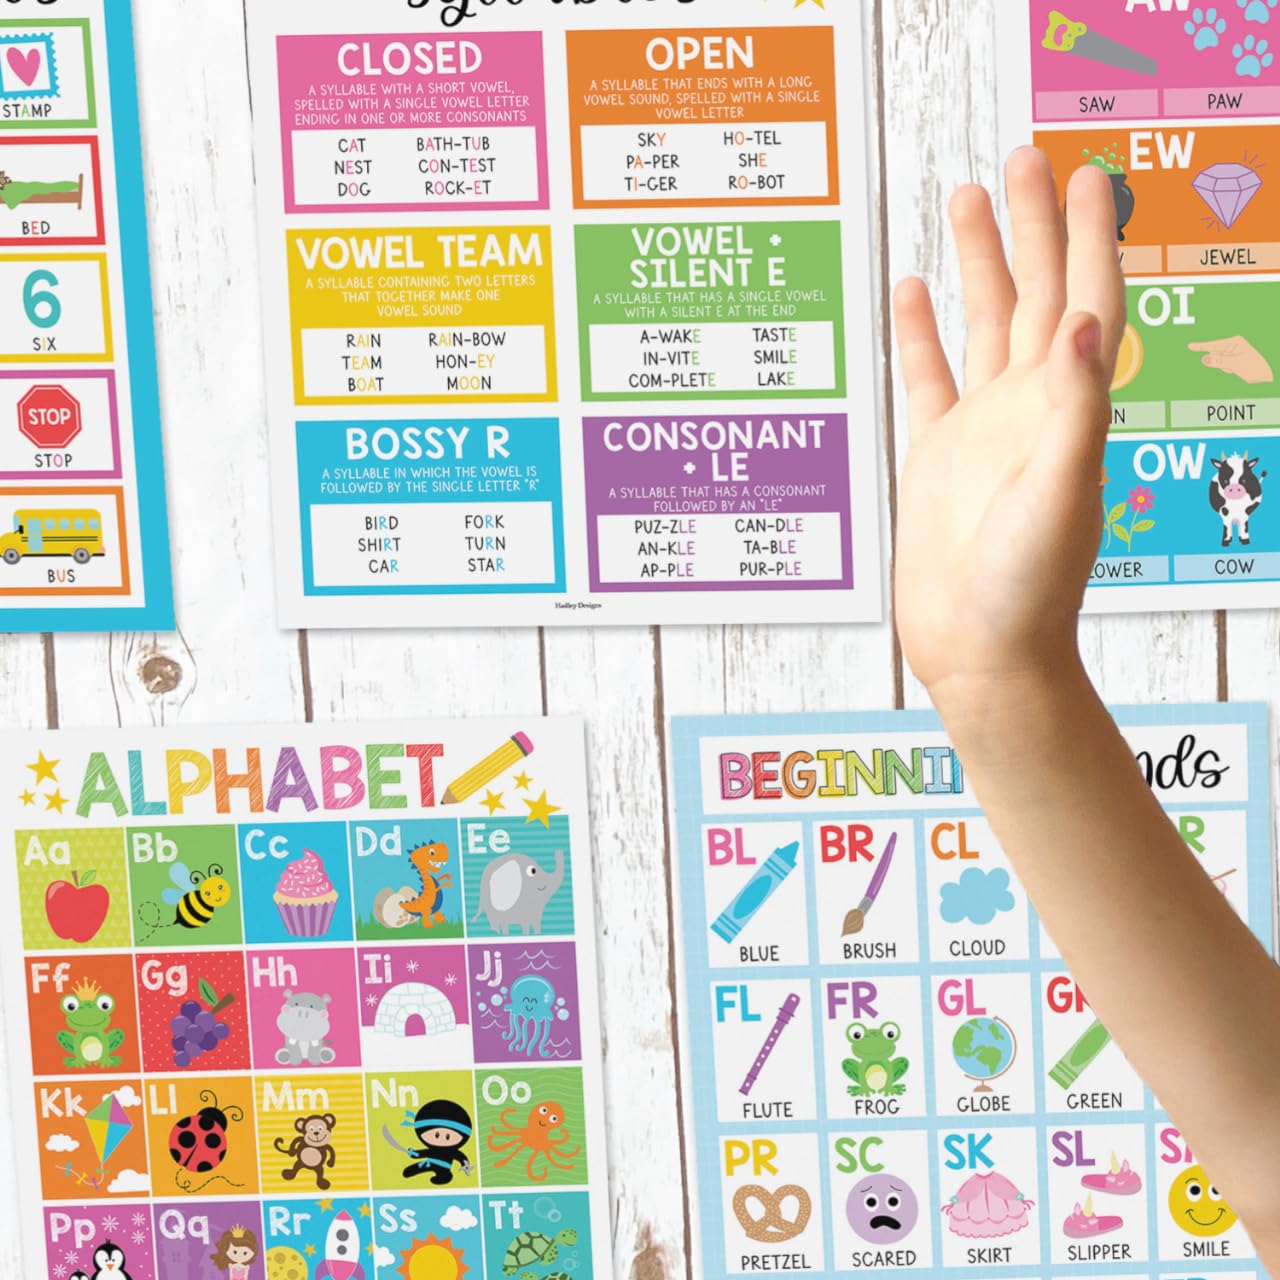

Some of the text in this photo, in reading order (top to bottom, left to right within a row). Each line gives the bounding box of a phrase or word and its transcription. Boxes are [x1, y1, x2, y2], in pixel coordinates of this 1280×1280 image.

[338, 41, 482, 76] CLOSED
[646, 36, 754, 71] OPEN
[308, 85, 316, 96] A
[321, 84, 376, 96] SYLLABLE
[381, 83, 411, 94] WITH
[416, 83, 424, 94] A
[428, 82, 465, 94] SHORT
[1080, 96, 1115, 112] SAW
[1208, 93, 1242, 109] PAW
[3, 104, 51, 118] STAMP
[338, 138, 366, 153] CAT
[417, 136, 489, 151] BATH-TUB
[638, 133, 665, 147] SKY
[724, 130, 781, 145] HO-TEL
[1130, 131, 1195, 170] EW
[334, 160, 372, 175] NEST
[419, 158, 496, 173] CON-TEST
[627, 154, 679, 169] PA-PER
[22, 221, 50, 235] BED
[631, 225, 753, 256] VOWEL
[296, 233, 543, 270] VOWEL TEAM
[1200, 248, 1256, 265] JEWEL
[630, 257, 786, 288] SILENT E
[23, 269, 61, 328] 6
[1137, 286, 1196, 327] OI
[640, 329, 699, 343] A-WAKE
[752, 328, 796, 342] TASTE
[33, 337, 56, 351] SIX
[629, 373, 714, 388] COM-PLETE
[28, 408, 71, 425] STOP
[1207, 404, 1256, 421] POINT
[346, 425, 510, 460] BOSSY R
[604, 420, 825, 452] CONSONANT
[35, 454, 72, 468] STOP
[712, 452, 749, 481] LE
[1133, 443, 1206, 481] OW
[321, 482, 383, 493] FOLLOWED
[388, 482, 400, 493] BY
[406, 481, 427, 492] THE
[432, 480, 473, 492] SINGLE
[478, 480, 520, 492] LETTER
[365, 516, 398, 530] BIRD
[465, 515, 504, 529] FORK
[635, 520, 696, 534] PUZ-ZLE
[735, 518, 803, 533] CAN-DLE
[1215, 559, 1254, 575] COW
[48, 569, 75, 583] BUS
[75, 743, 444, 818] ALPHABET
[719, 746, 963, 800] BEGINNI
[24, 834, 71, 867] Aa
[132, 832, 178, 864] Bb
[245, 829, 289, 860] Cc
[820, 824, 875, 863] BR
[740, 945, 779, 962] BLUE
[843, 942, 896, 959] BRUSH
[950, 939, 1005, 956] CLOUD
[141, 960, 188, 996] Gg
[957, 1096, 1010, 1112] GLOBE
[1067, 1093, 1122, 1109] GREEN
[743, 1102, 793, 1118] FLUTE
[968, 1247, 1012, 1264] SKIRT
[1068, 1244, 1131, 1261] SLIPPER
[1183, 1241, 1230, 1257] SMILE
[742, 1254, 811, 1270] PRETZEL
[852, 1250, 916, 1267] SCARED
